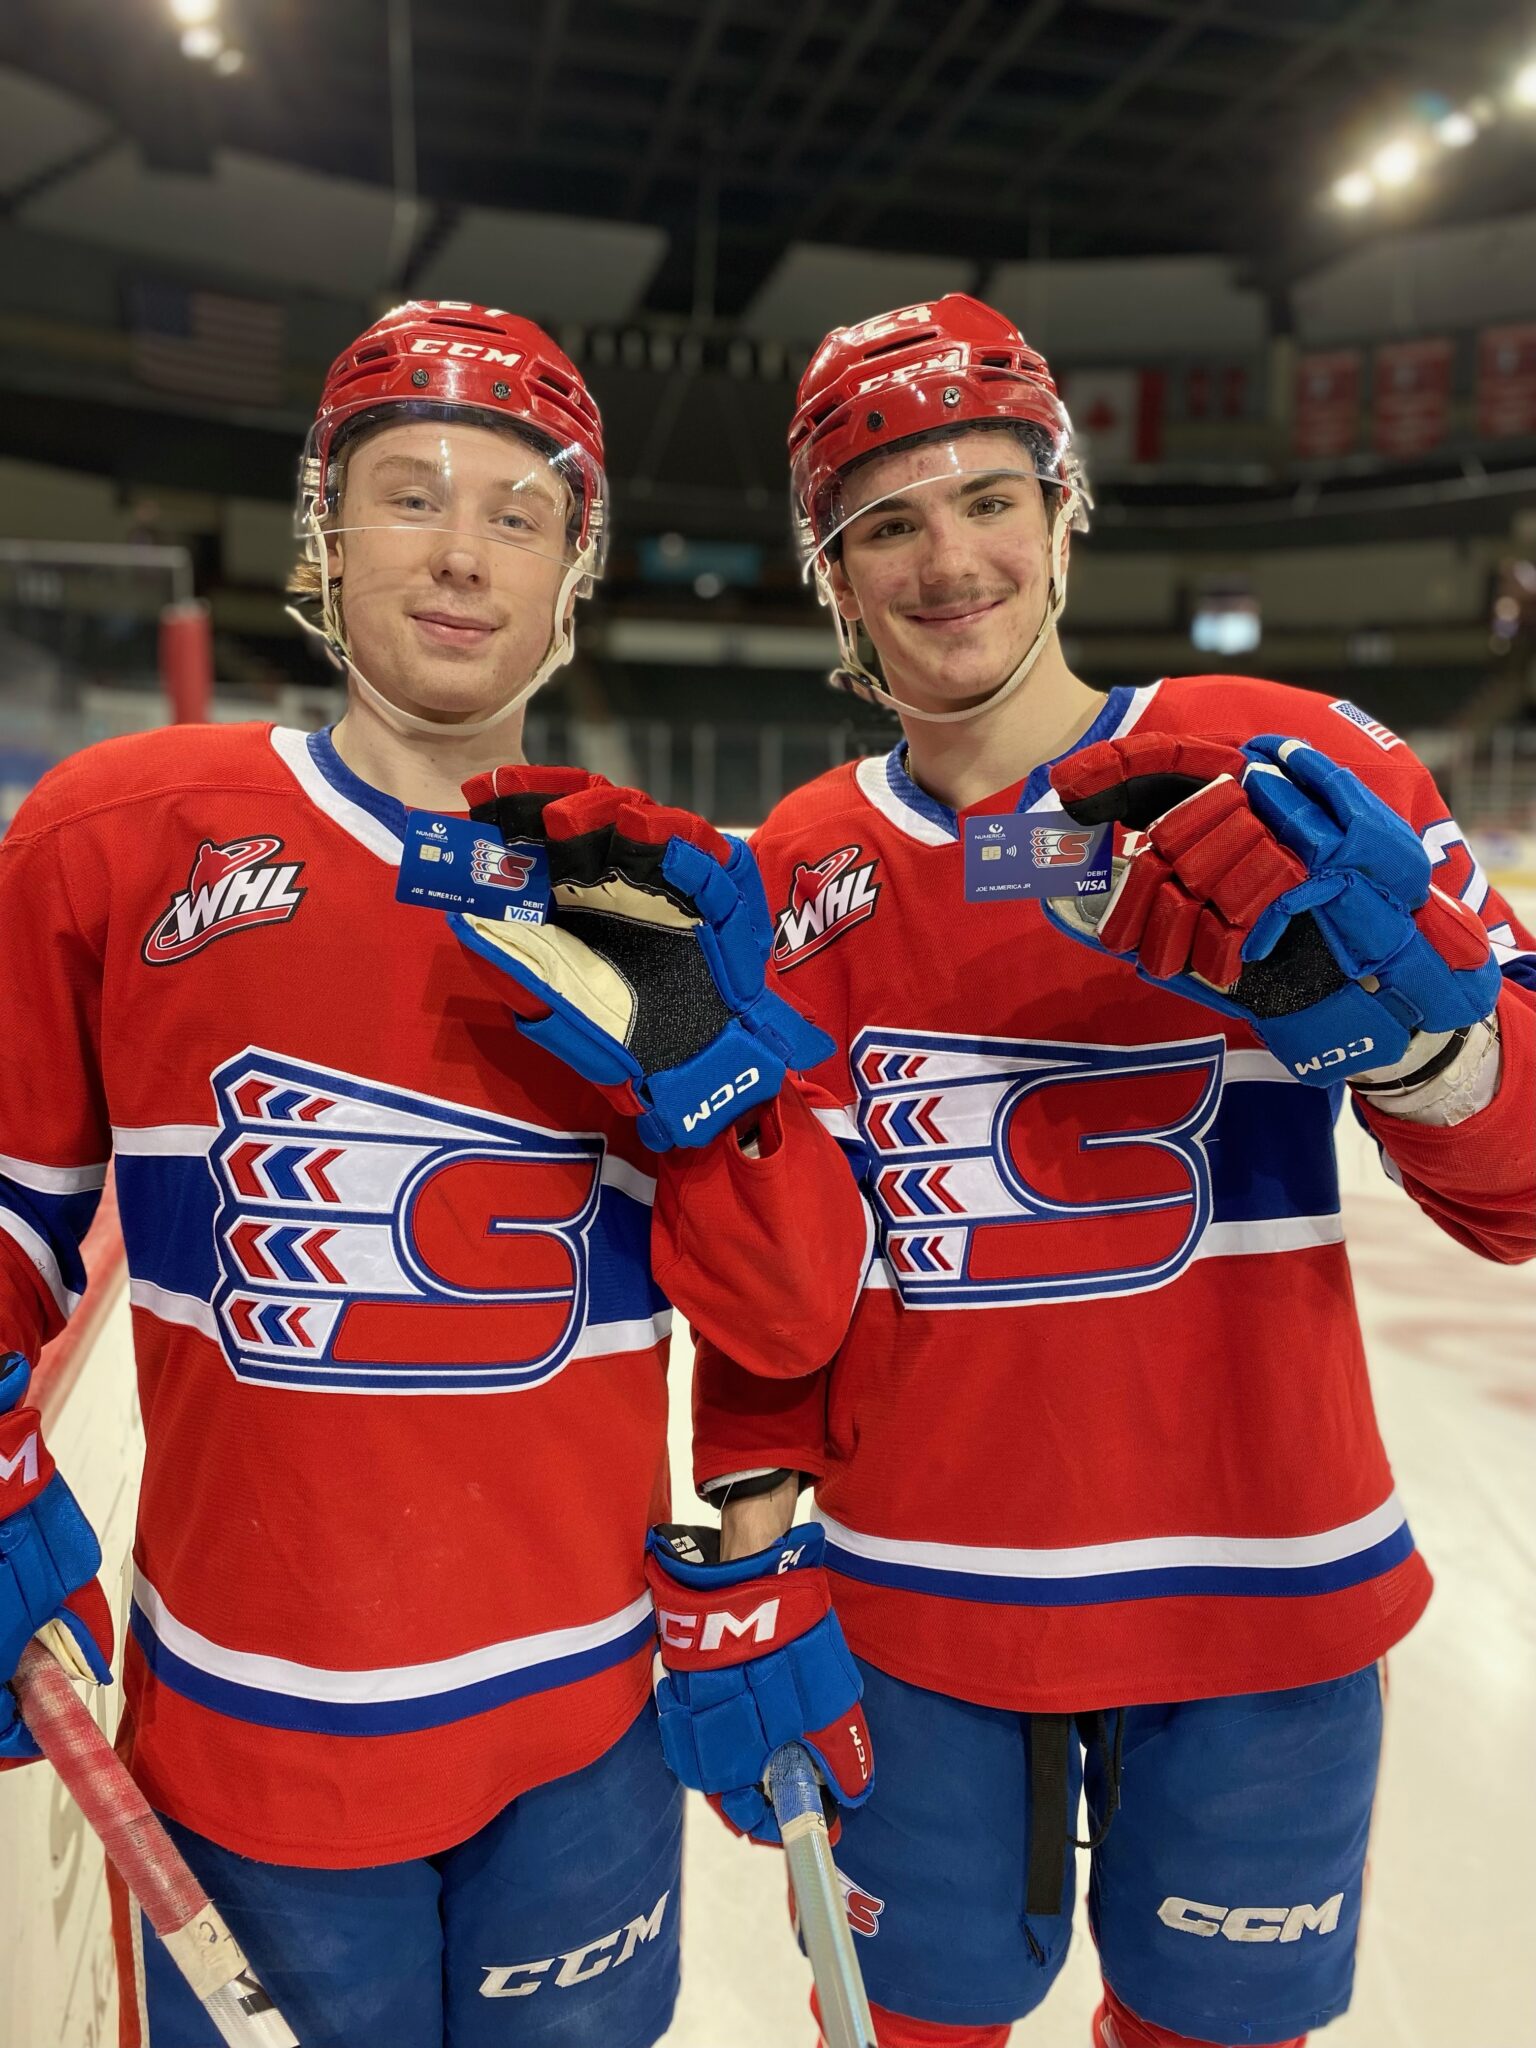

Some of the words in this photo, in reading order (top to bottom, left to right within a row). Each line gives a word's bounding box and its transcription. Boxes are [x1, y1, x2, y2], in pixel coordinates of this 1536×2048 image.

[409, 338, 523, 368] CCM
[415, 829, 449, 841] NUMERICA
[974, 832, 1006, 840] NUMERICA
[411, 887, 424, 895] JOE
[427, 889, 462, 902] NUMERICA
[989, 883, 1022, 891] NUMERICA
[1074, 880, 1107, 892] VISA
[175, 866, 301, 942] WHL
[509, 907, 540, 923] VISA
[522, 899, 544, 910] DEBIT
[779, 864, 877, 951] WHL
[1294, 1036, 1375, 1076] CCM
[682, 1067, 760, 1132] CCM
[777, 1544, 807, 1575] 24
[659, 1597, 780, 1651] CM
[1157, 1892, 1344, 1943] CCM
[478, 1890, 670, 1998] CCM
